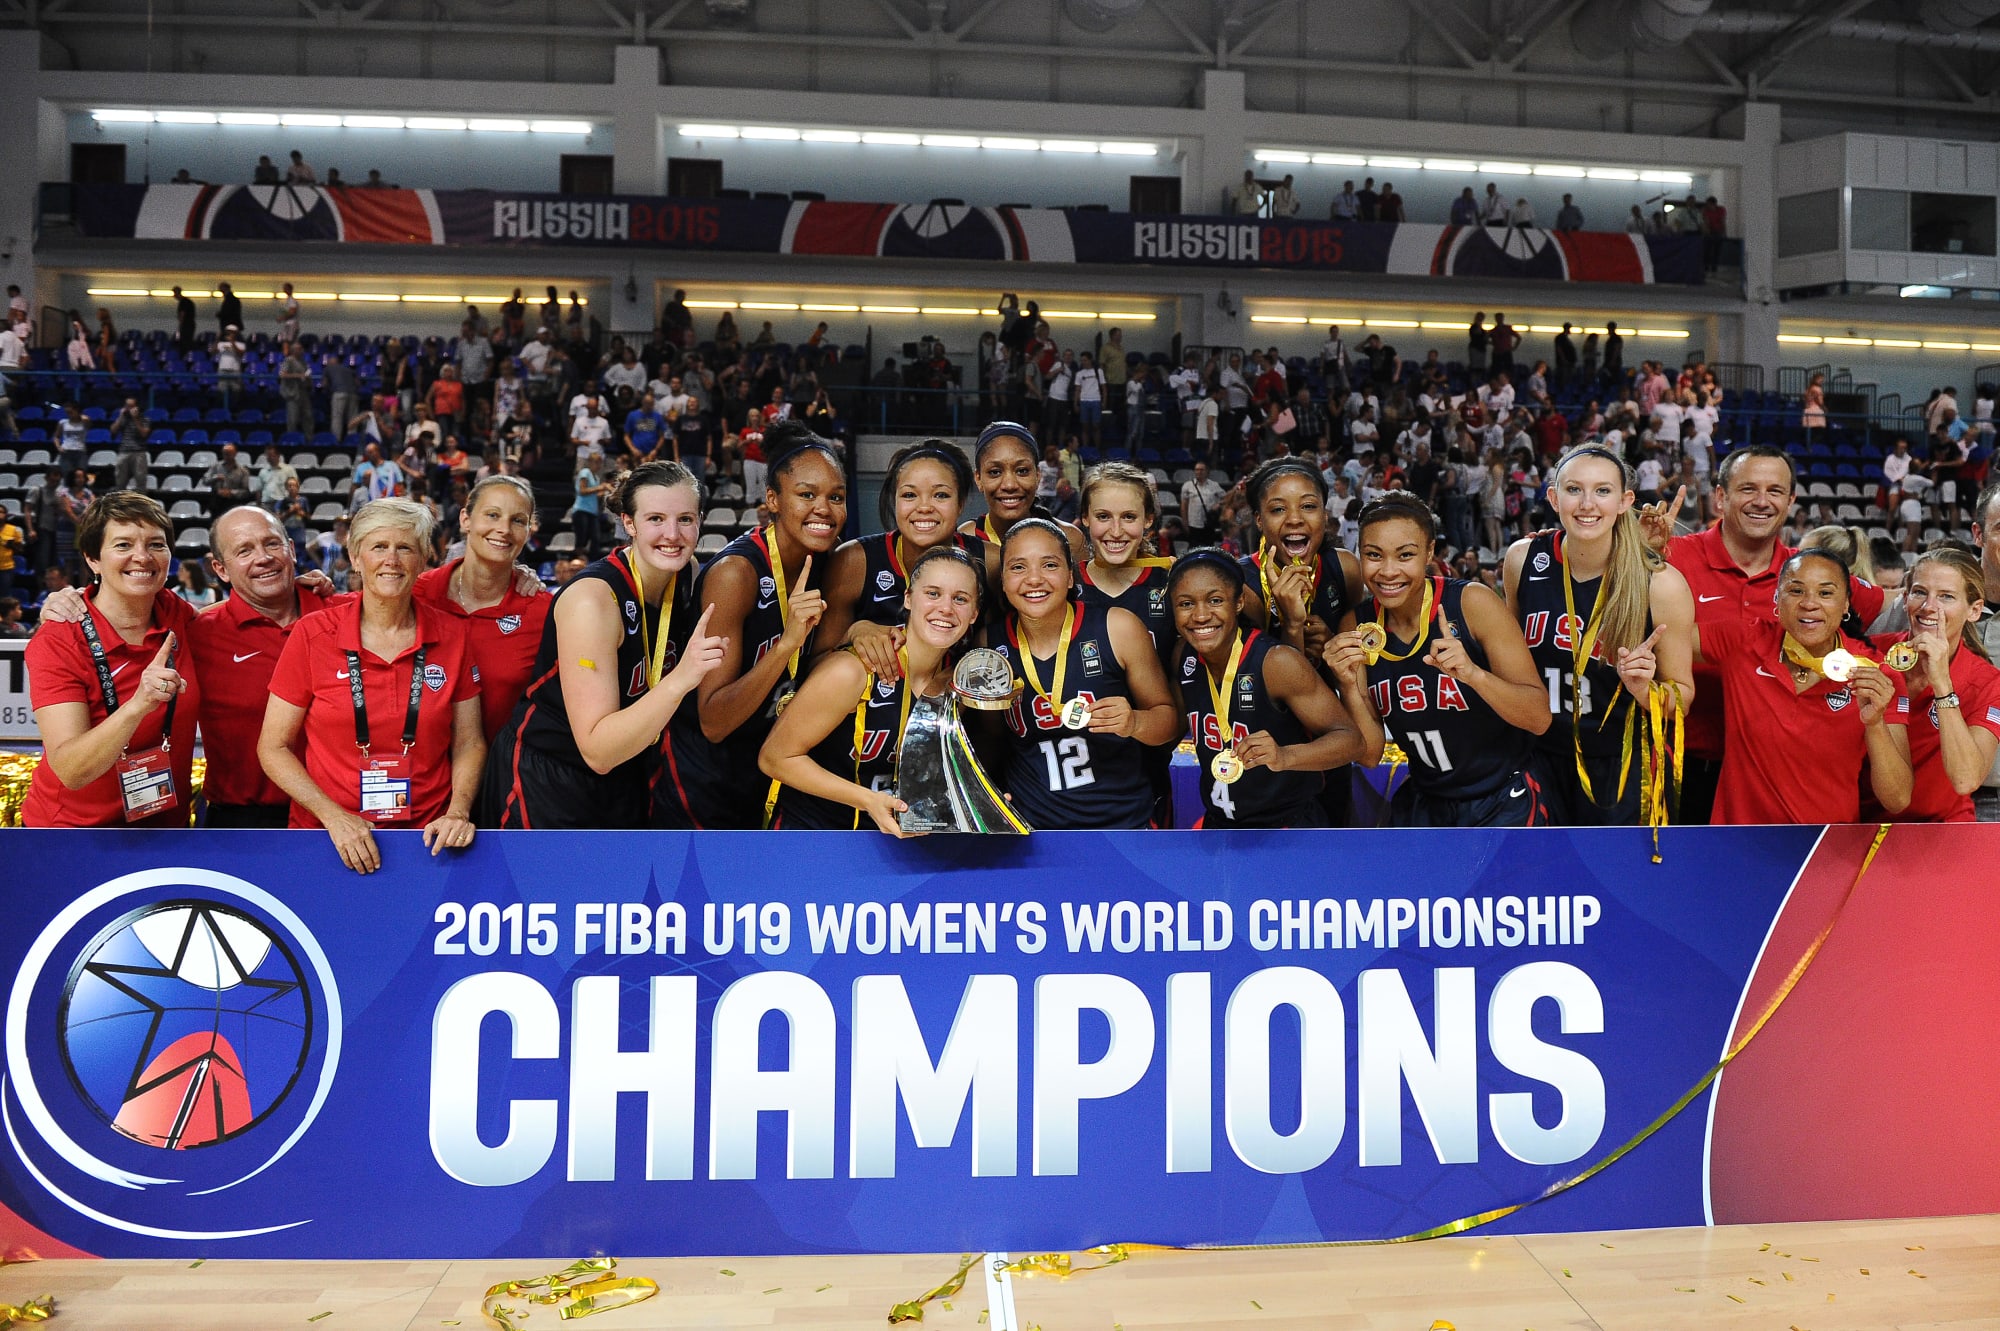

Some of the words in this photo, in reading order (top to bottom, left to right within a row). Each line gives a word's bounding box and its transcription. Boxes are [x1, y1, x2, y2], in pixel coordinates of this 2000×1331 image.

[493, 200, 629, 240] RUSSIA
[631, 204, 720, 243] 2015
[1134, 221, 1260, 261] RUSSIA
[1262, 226, 1344, 264] 2015
[1368, 674, 1470, 718] USA
[1544, 667, 1592, 714] 13
[3, 706, 38, 725] 85
[1038, 736, 1096, 792] 12
[1406, 730, 1453, 772] 11
[1210, 780, 1236, 820] 4
[434, 902, 558, 956] 2015
[574, 902, 687, 956] FIBA
[703, 902, 791, 956] U19
[804, 901, 1047, 955] WOMEN'S
[1061, 900, 1233, 954] WORLD
[1249, 895, 1601, 952] CHAMPIONSHIP
[429, 960, 1606, 1188] CHAMPIONS
